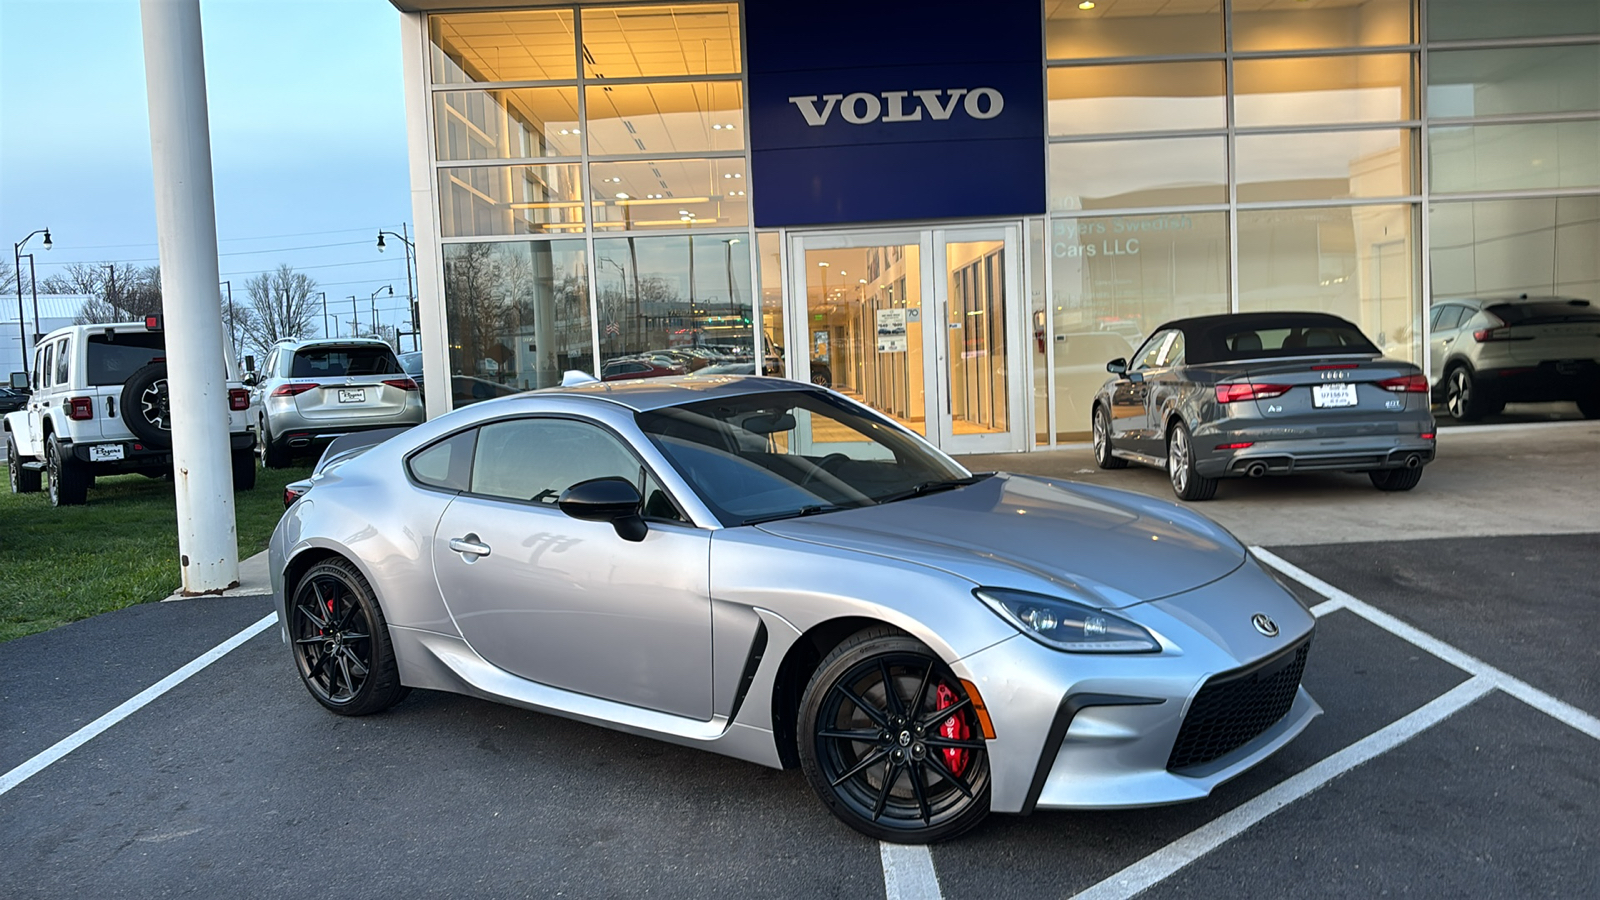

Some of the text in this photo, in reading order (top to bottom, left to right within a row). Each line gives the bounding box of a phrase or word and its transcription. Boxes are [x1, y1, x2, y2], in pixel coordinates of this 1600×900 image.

[788, 86, 1004, 126] VOLVO
[1053, 214, 1192, 238] Byers Swedish
[1053, 238, 1140, 258] Cars LLC
[908, 309, 918, 317] 70
